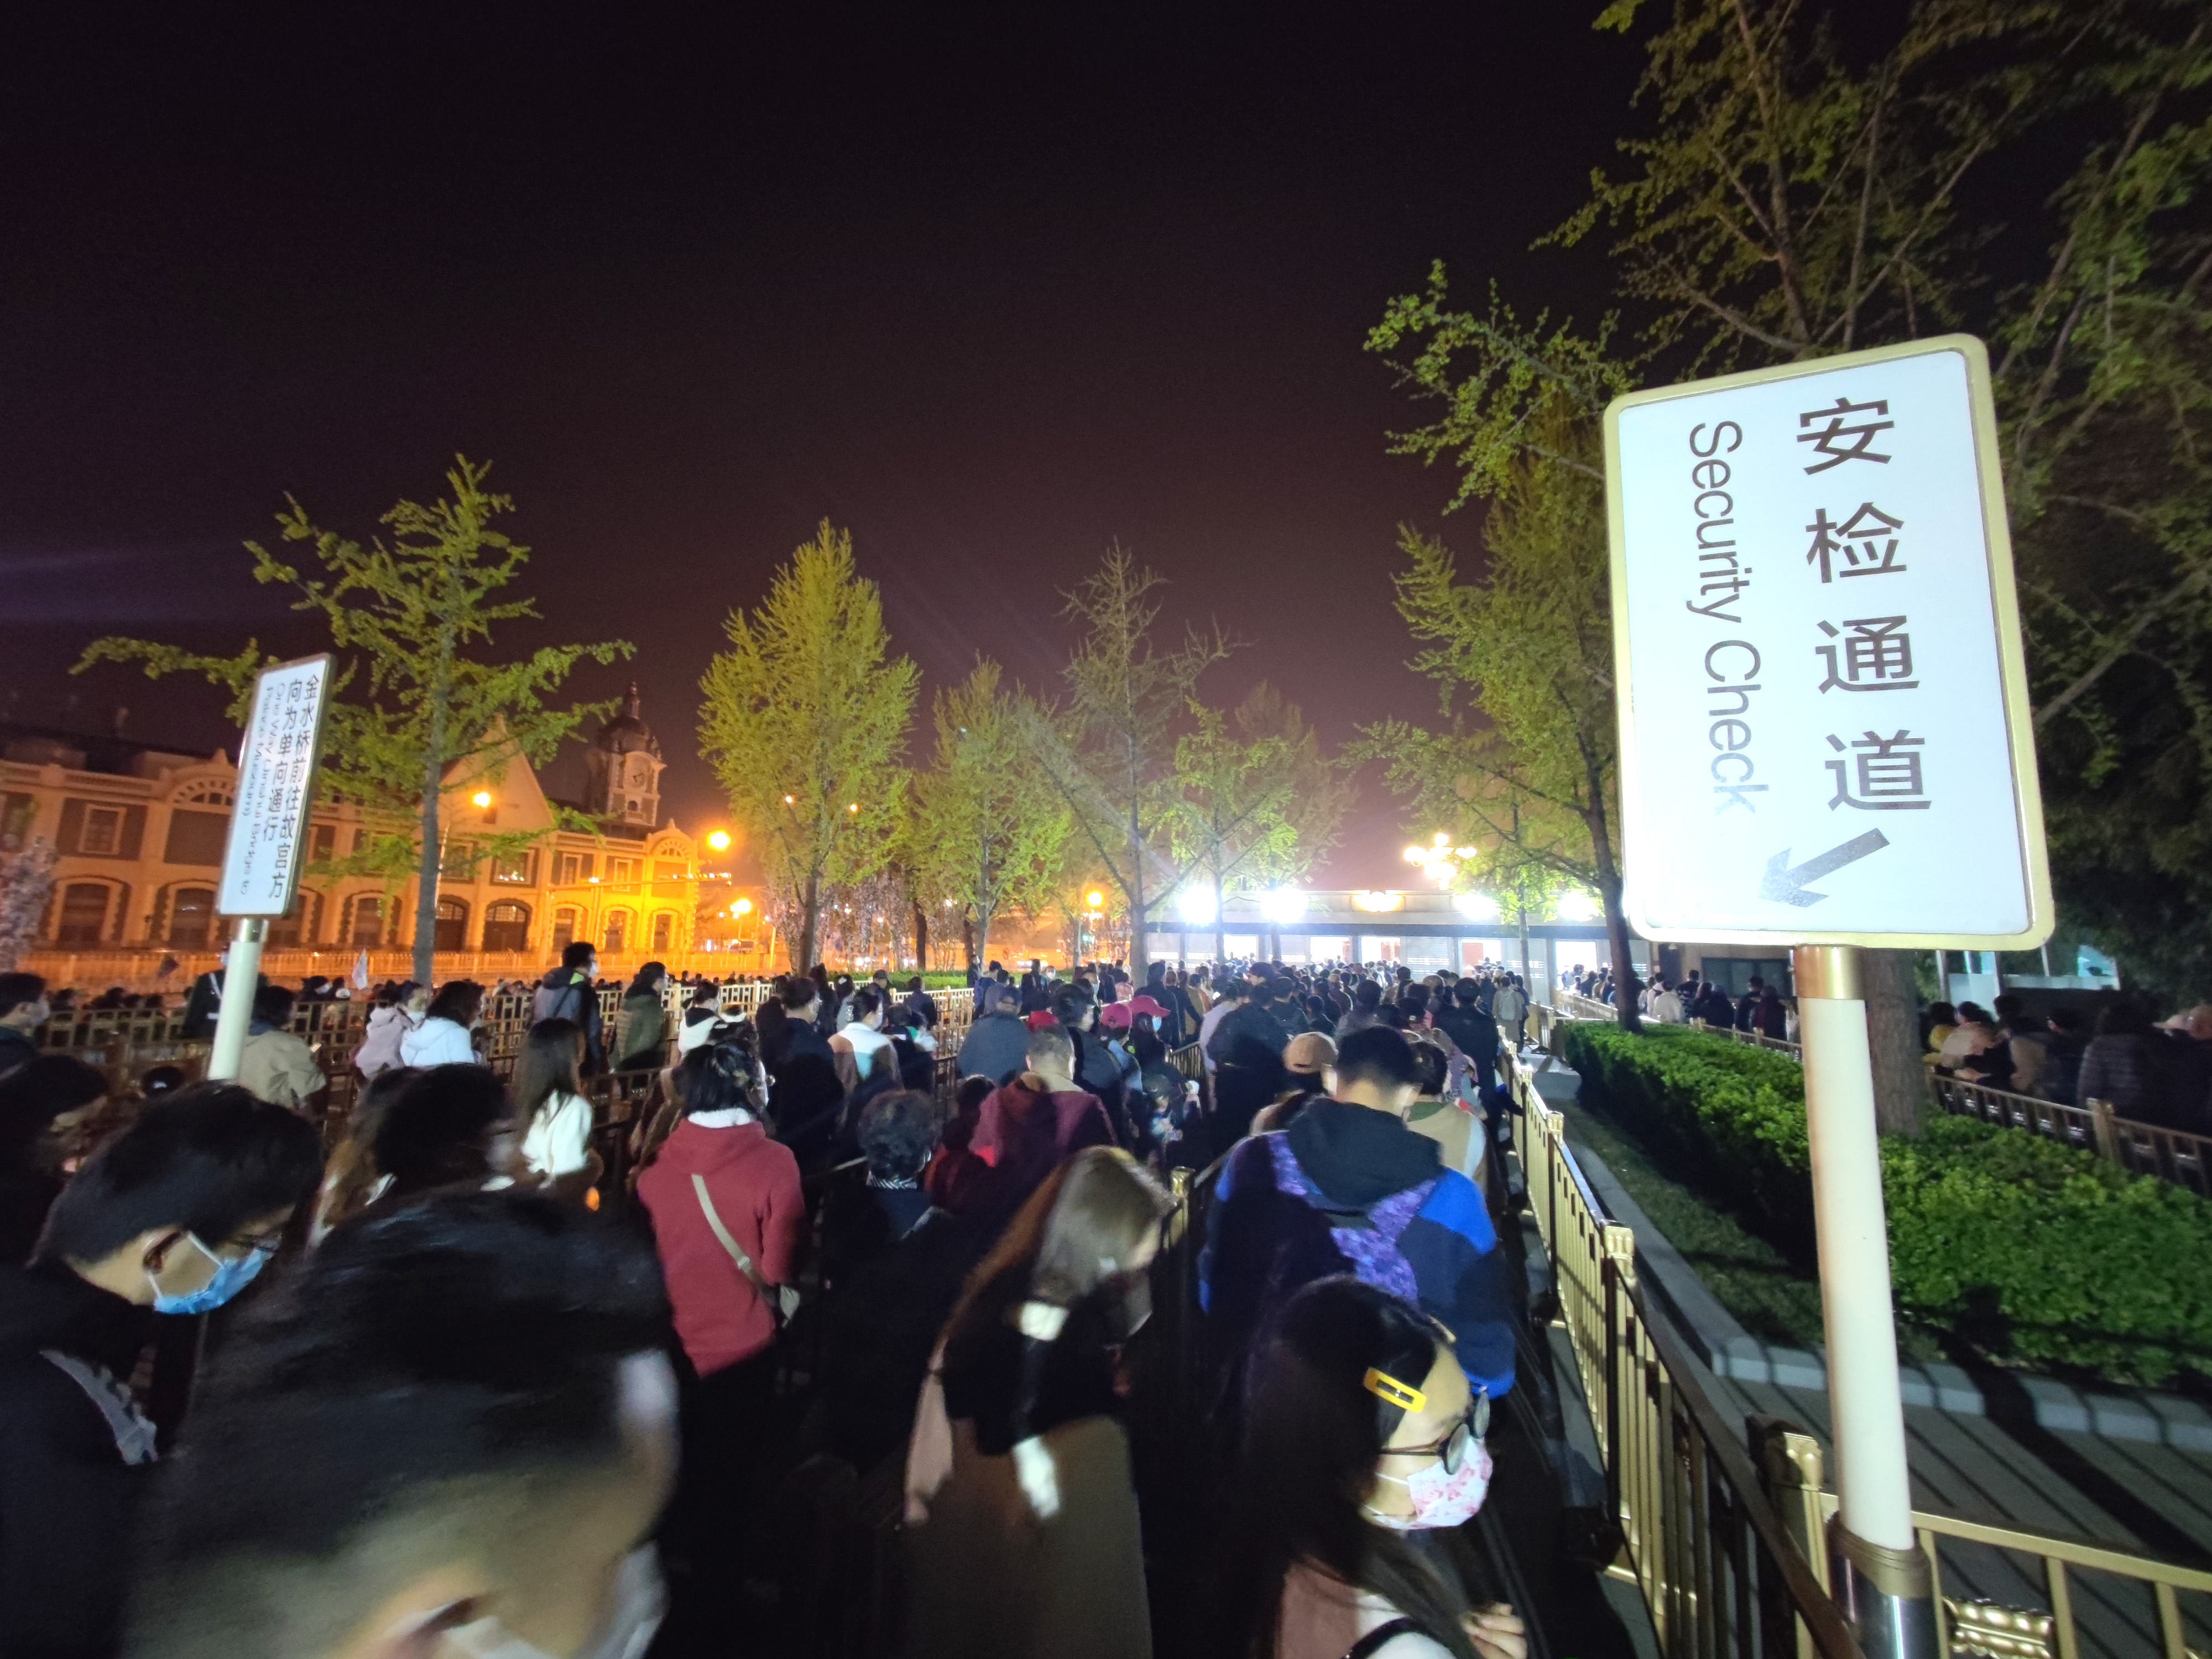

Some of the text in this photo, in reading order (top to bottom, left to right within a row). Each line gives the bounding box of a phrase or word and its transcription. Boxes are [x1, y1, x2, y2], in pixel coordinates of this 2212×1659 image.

[1686, 420, 1770, 815] Security Check
[1796, 397, 1932, 810] 安检通道
[263, 678, 302, 842] 向为单向通行
[269, 674, 320, 899] 金水桥前往故宫方
